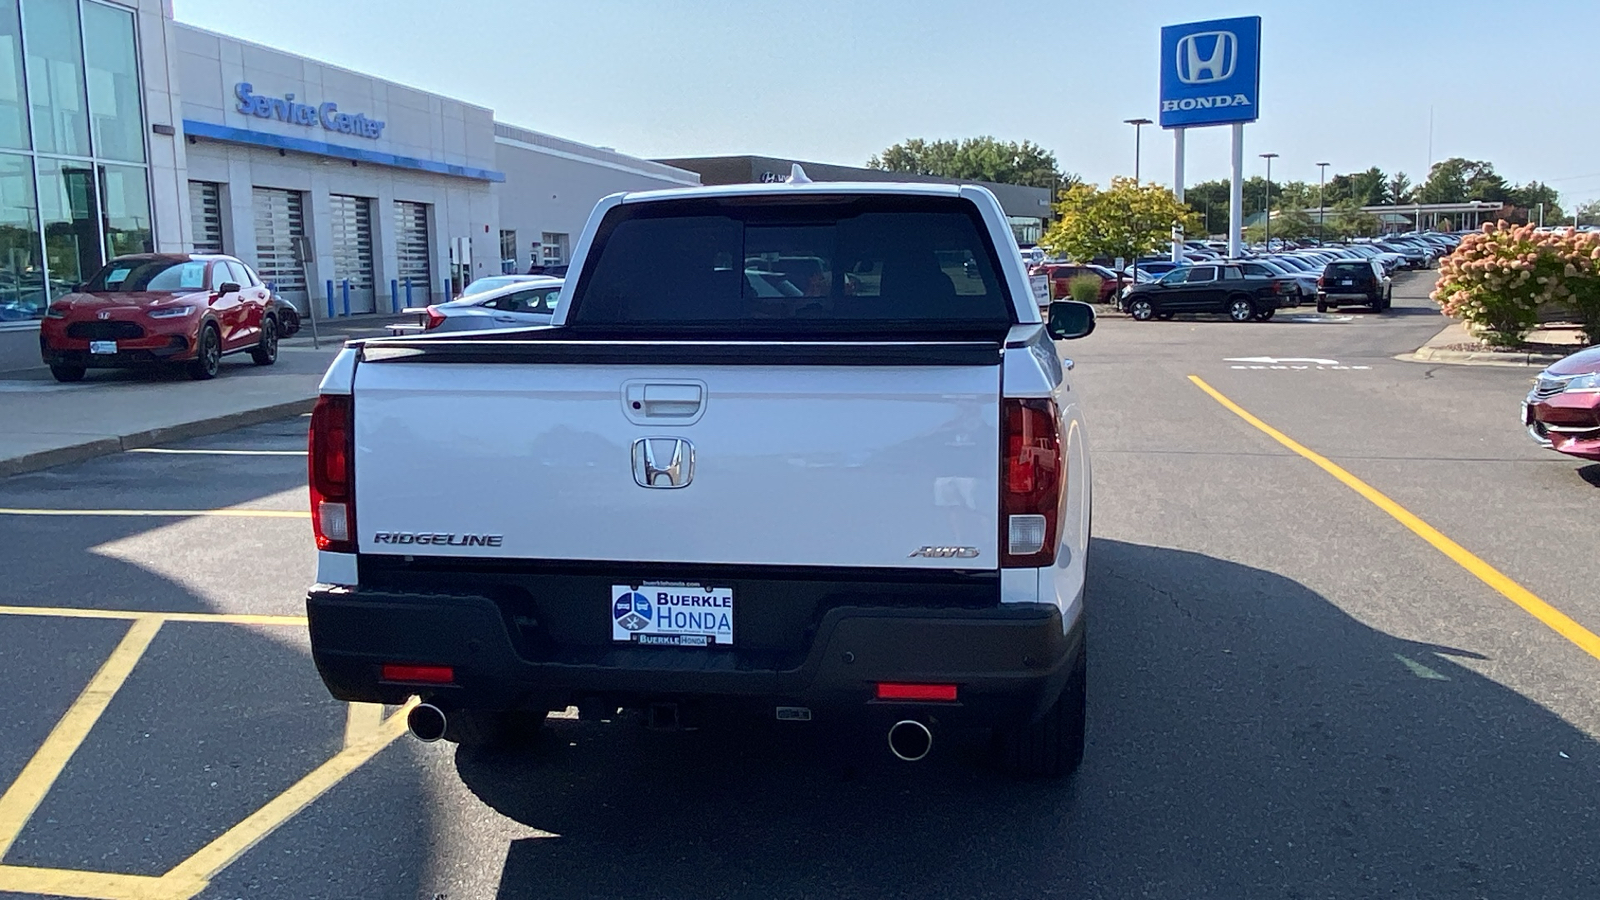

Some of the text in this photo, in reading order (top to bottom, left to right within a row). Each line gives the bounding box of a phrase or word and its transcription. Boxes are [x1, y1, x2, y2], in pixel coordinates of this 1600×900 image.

[234, 82, 385, 139] Service Center
[1162, 94, 1252, 112] HONDA
[373, 531, 504, 547] RIDGELINE
[907, 546, 980, 558] AWD
[656, 592, 731, 608] BUERKLE
[657, 606, 731, 631] HONDA
[639, 634, 706, 645] BUERKLE HONDA
